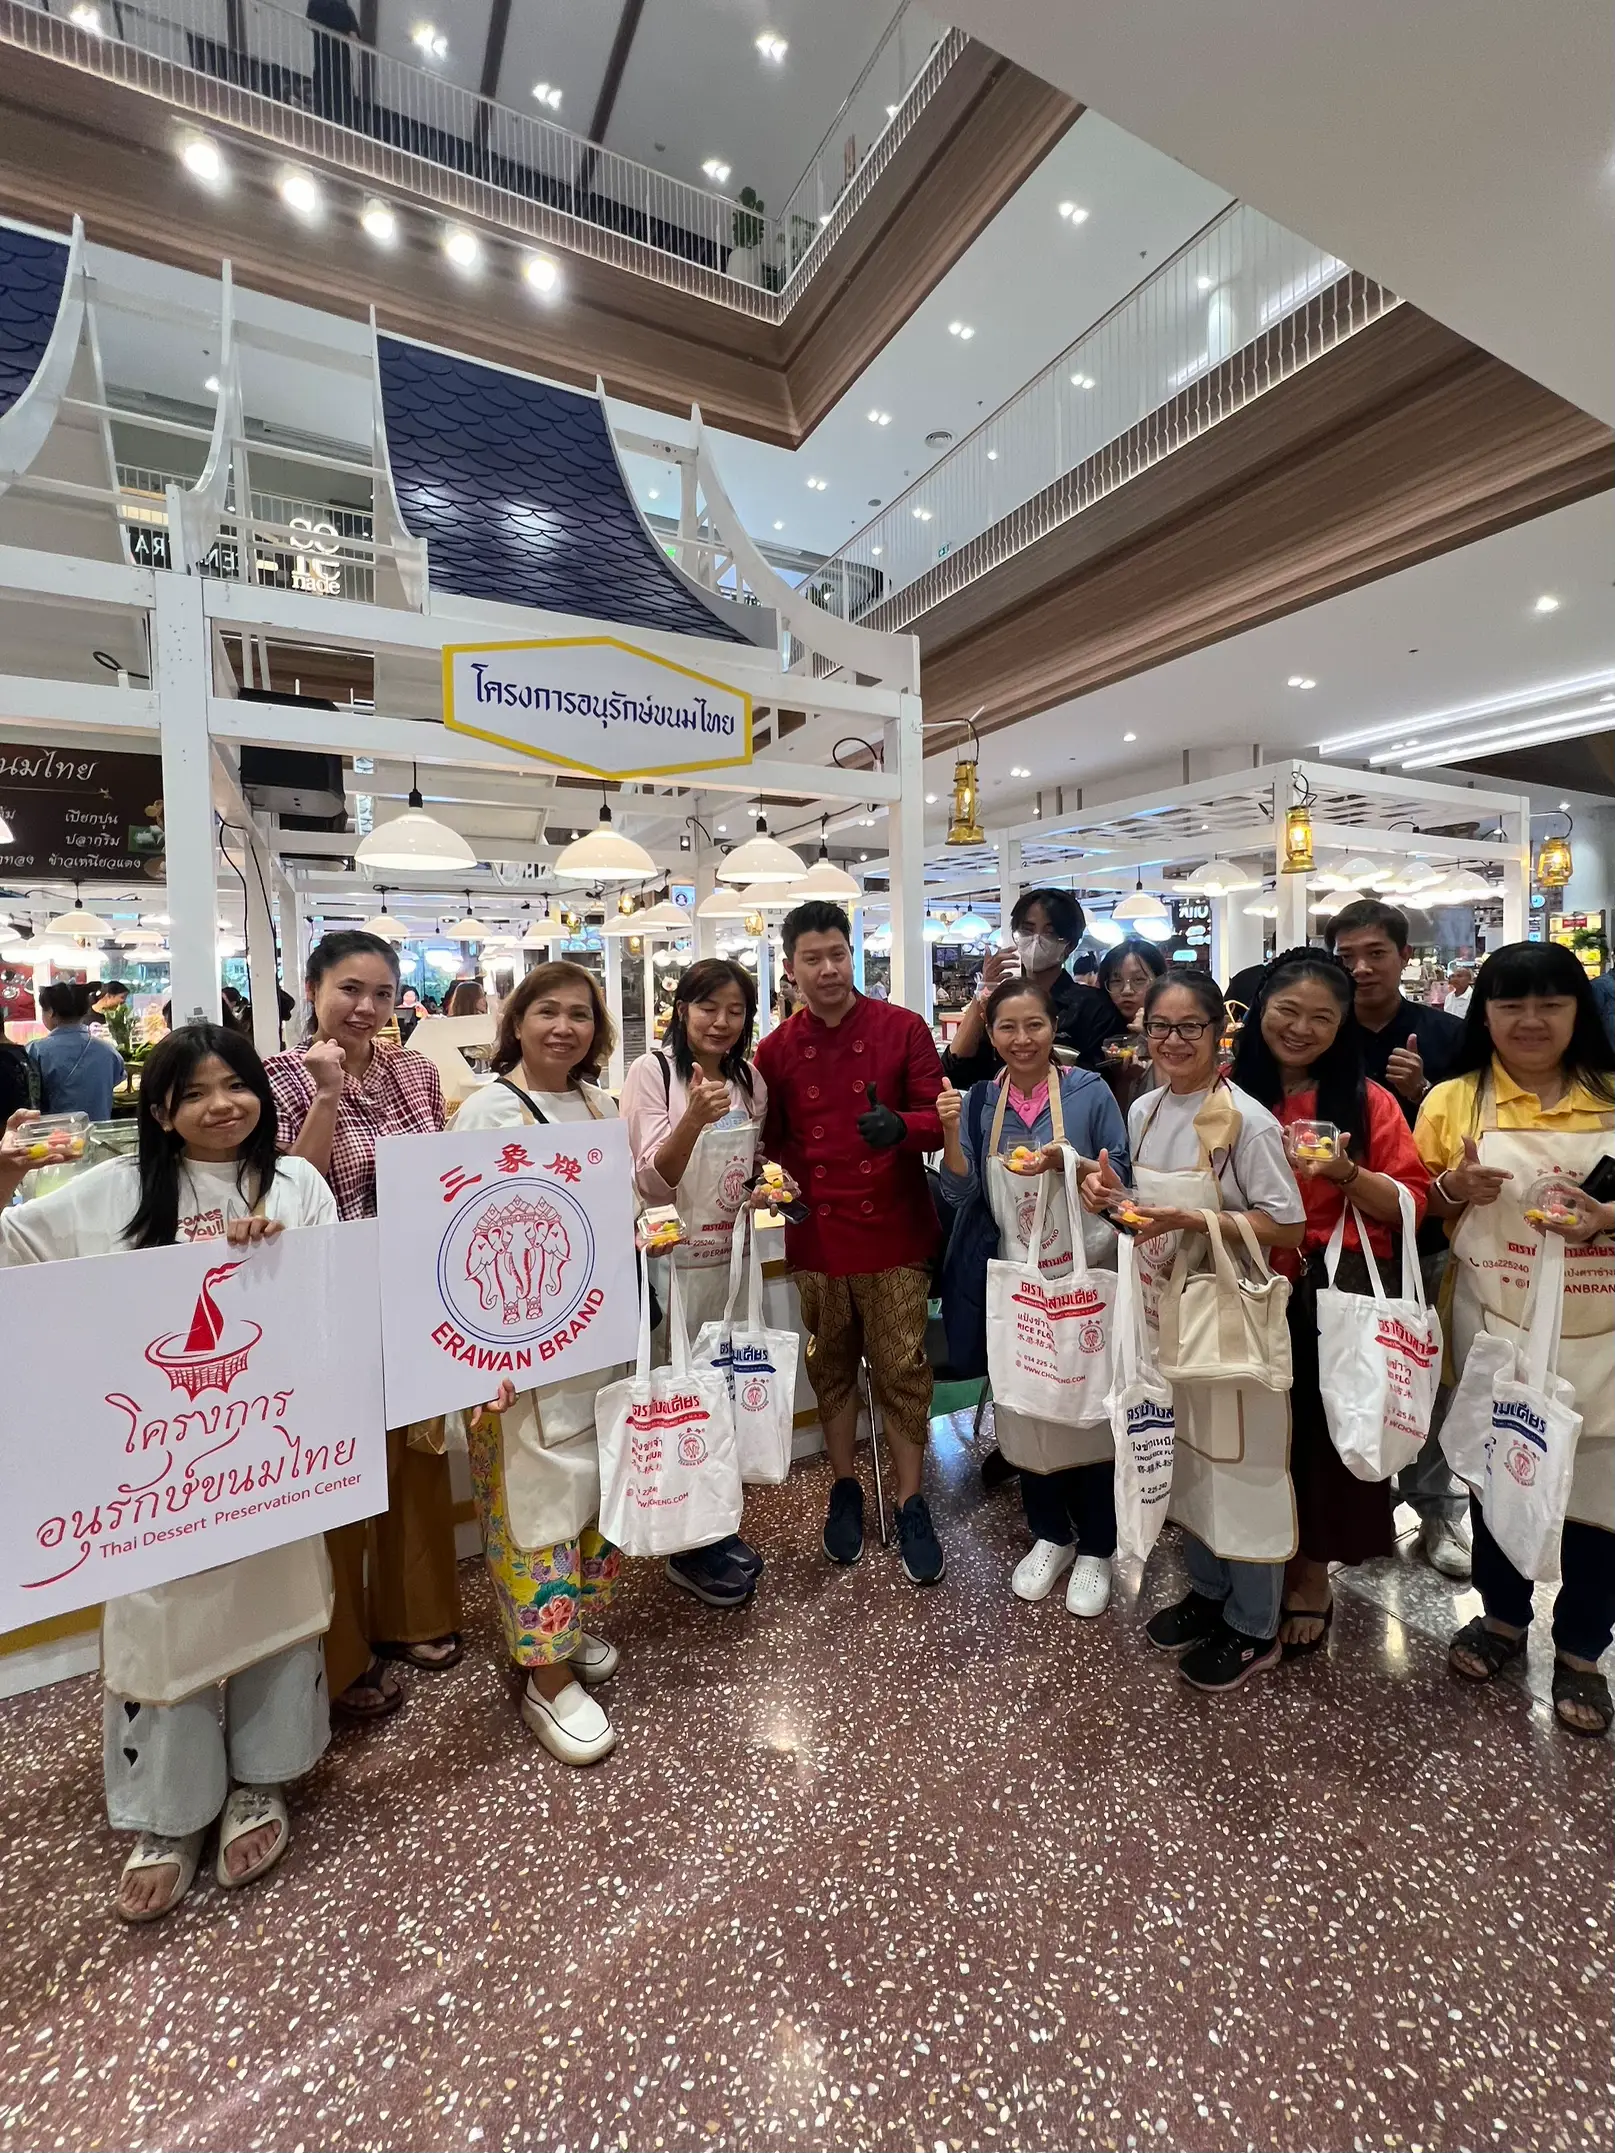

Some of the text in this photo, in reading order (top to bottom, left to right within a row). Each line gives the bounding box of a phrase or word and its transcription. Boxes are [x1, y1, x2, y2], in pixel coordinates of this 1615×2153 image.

[291, 573, 341, 595] nade
[470, 662, 735, 736] โครงการอนุรักษ์ขนมไทย
[431, 1288, 605, 1372] ERAWAN BRAND
[1017, 1323, 1034, 1334] RICE
[105, 1389, 295, 1454] โครงการ
[20, 1425, 357, 1588] อนุรักษ์ขนมไทย
[99, 1472, 362, 1559] Thai Dessert Preservation Center
